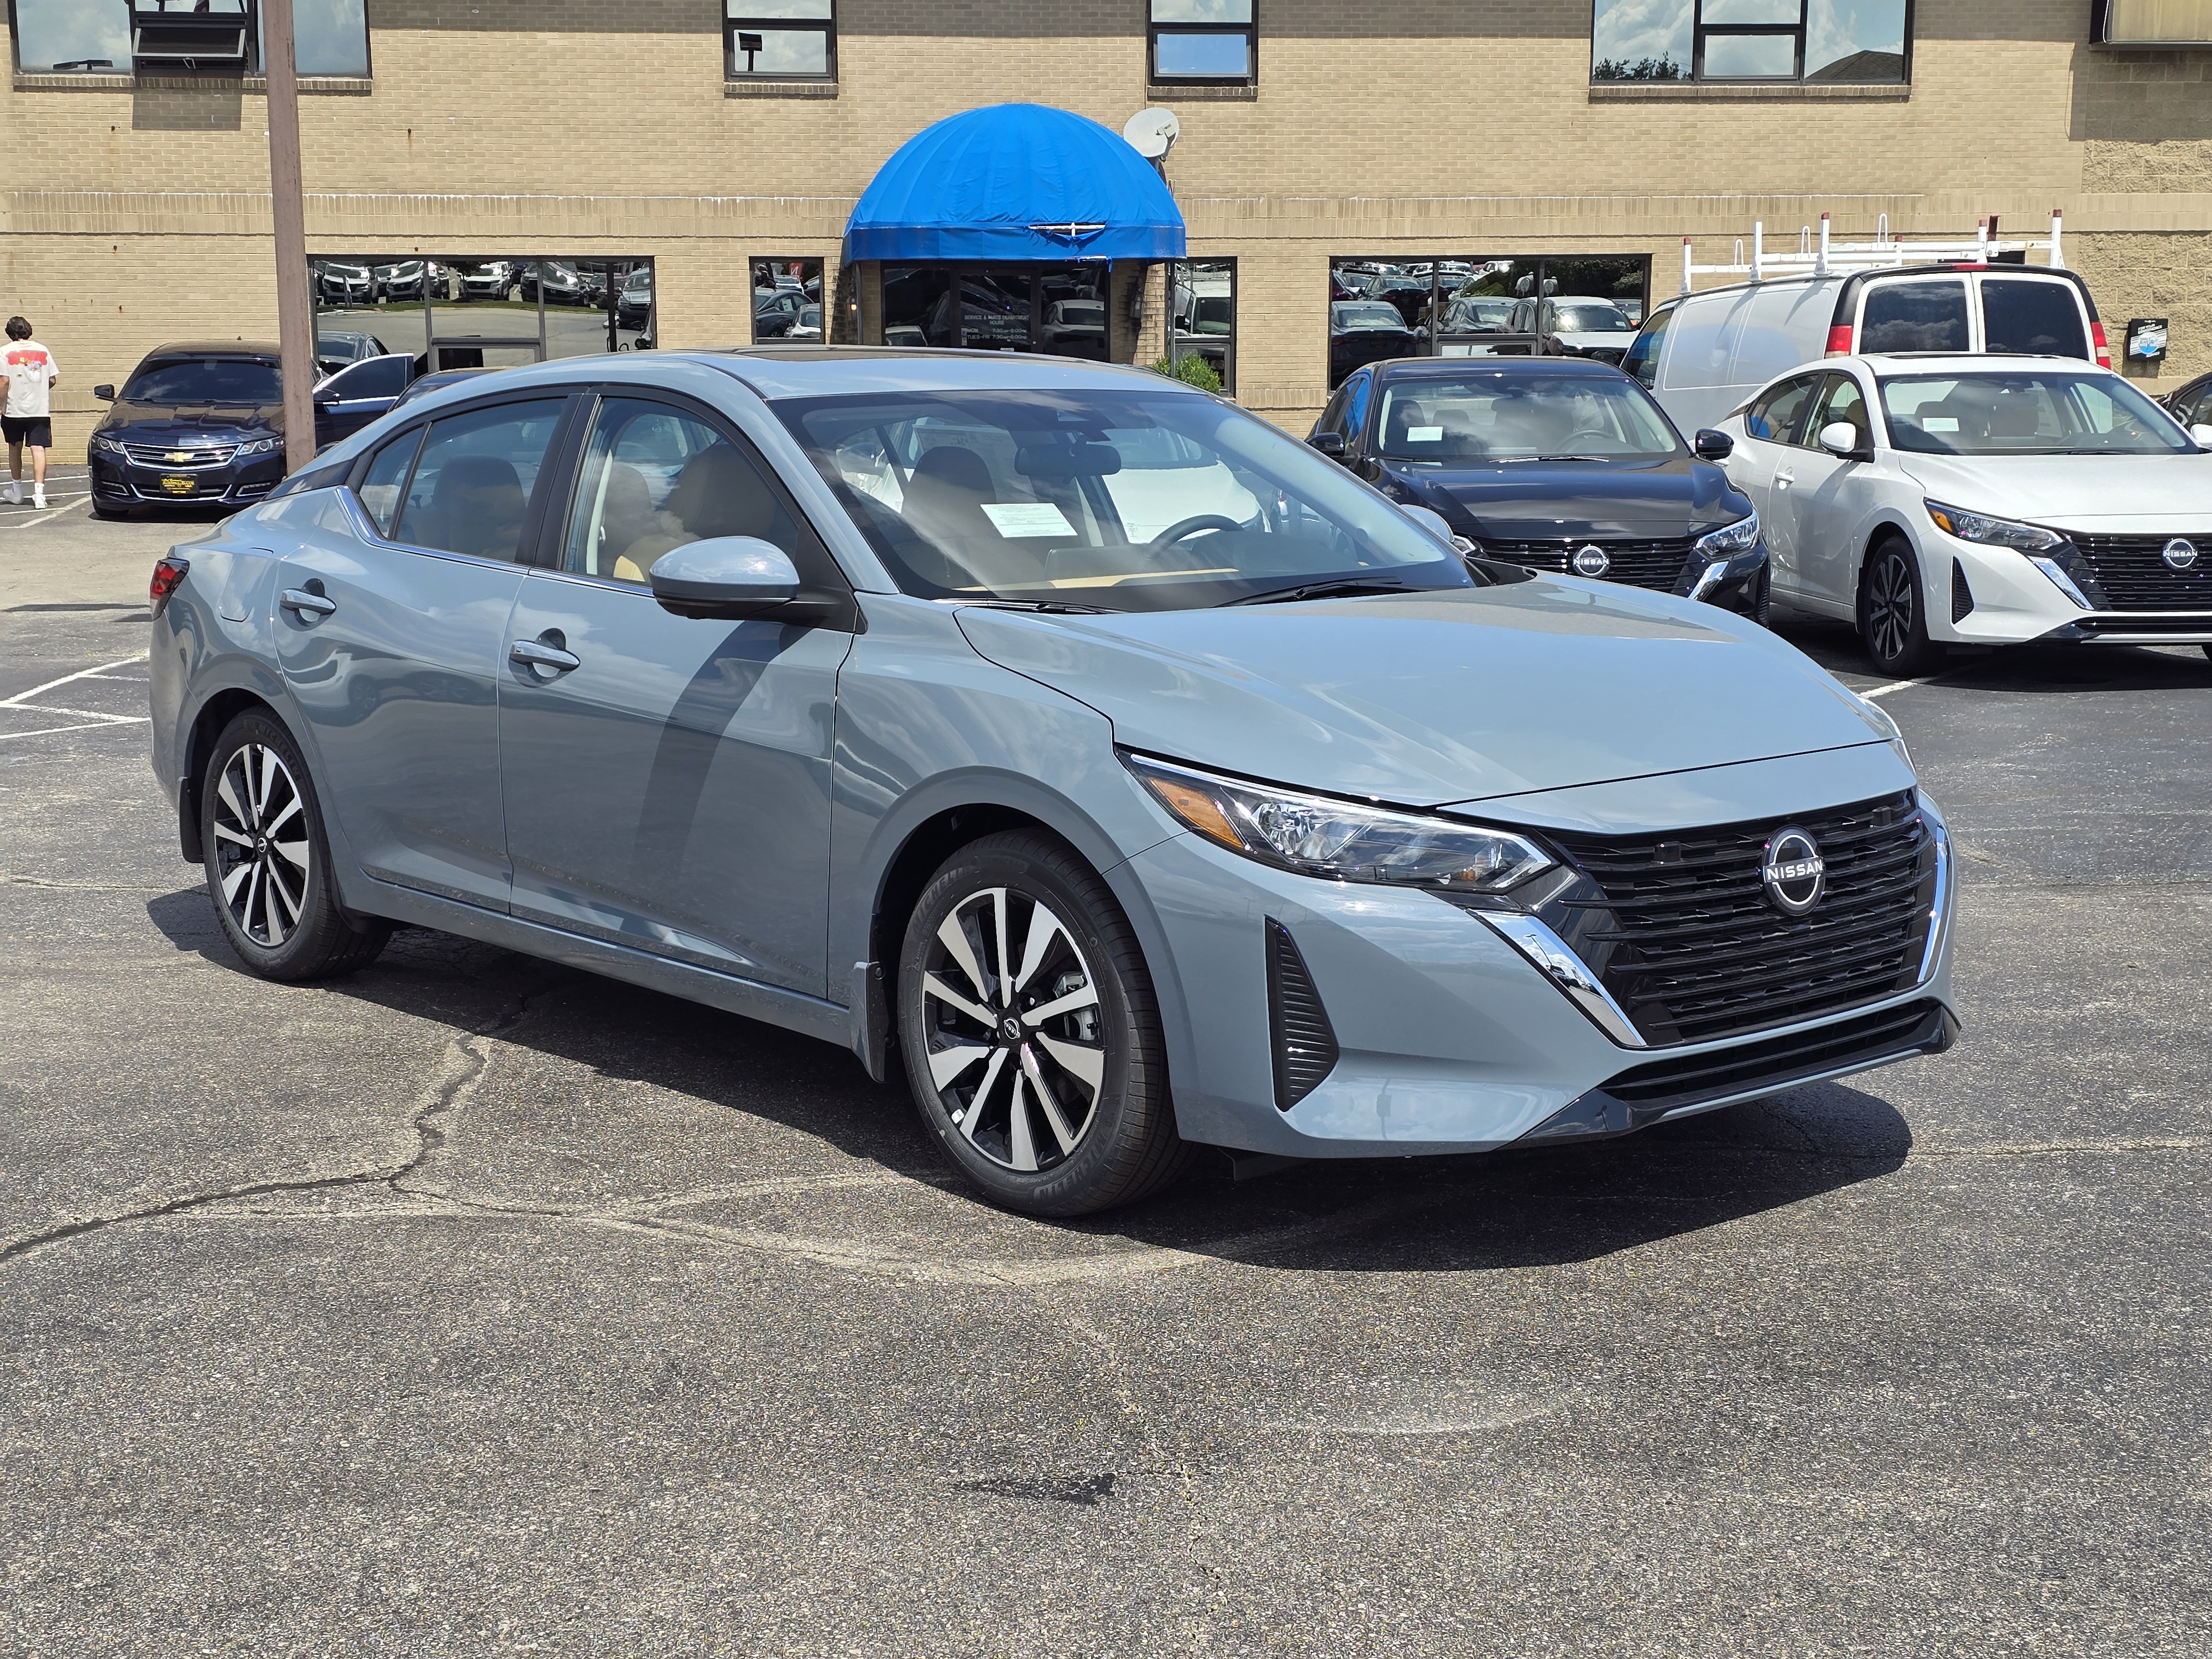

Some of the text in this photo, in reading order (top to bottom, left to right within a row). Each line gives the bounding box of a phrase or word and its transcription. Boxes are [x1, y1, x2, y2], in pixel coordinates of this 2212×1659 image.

[258, 723, 300, 776] MICHELIN
[1767, 859, 1823, 880] NISSAN
[1033, 1130, 1108, 1200] MICHELIN
